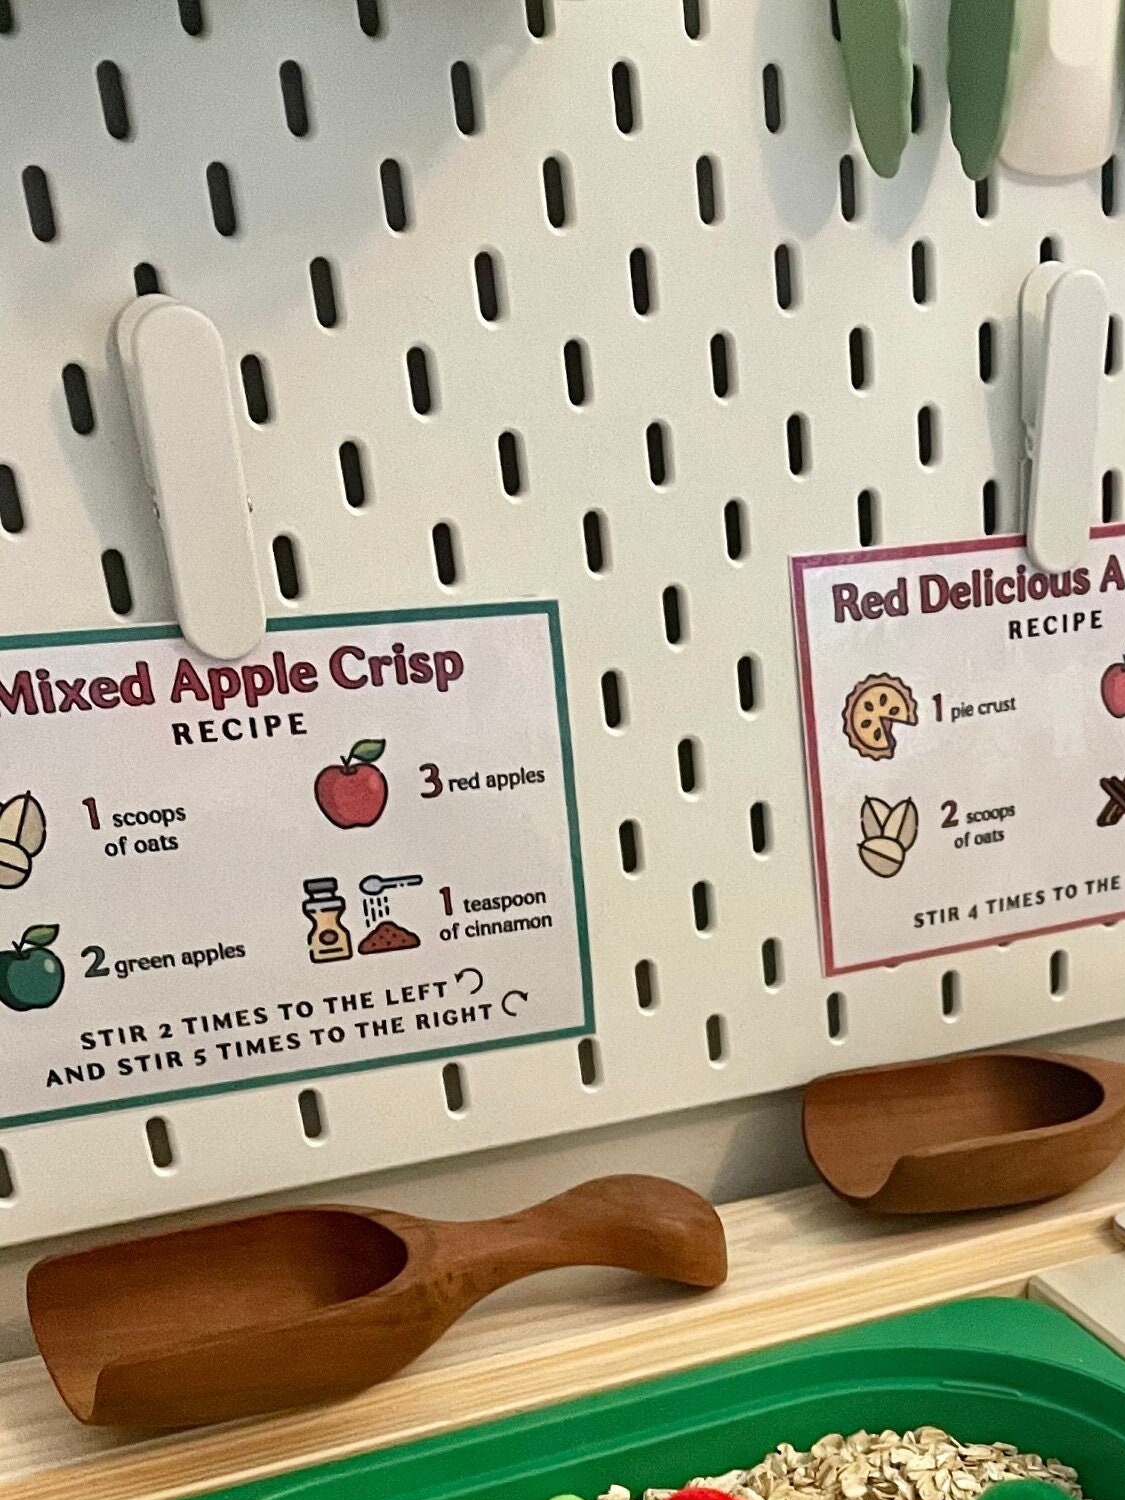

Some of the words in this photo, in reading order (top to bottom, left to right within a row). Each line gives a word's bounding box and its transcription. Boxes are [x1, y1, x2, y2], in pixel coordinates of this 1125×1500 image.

[832, 577, 909, 623] Red
[919, 564, 1091, 613] Delicious
[1008, 610, 1103, 640] RECIPE
[0, 661, 156, 715] Mixed
[170, 651, 319, 711] Apple
[329, 642, 464, 692] Crisp
[932, 693, 943, 722] 1
[951, 702, 974, 723] pie
[978, 697, 1017, 715] crust
[171, 712, 308, 745] RECIPE
[419, 763, 443, 799] 3
[448, 772, 480, 792] red
[486, 766, 545, 791] apples
[82, 796, 100, 830] 1
[112, 807, 186, 828] scoops
[941, 800, 959, 828] 2
[966, 805, 1016, 824] scoops
[105, 836, 127, 857] of
[134, 835, 179, 854] oats
[954, 831, 971, 849] of
[974, 830, 1005, 845] oats
[439, 886, 453, 916] 1
[463, 891, 546, 913] teaspoon
[913, 906, 959, 928] STIR
[968, 904, 978, 920] 4
[985, 890, 1045, 914] TIMES
[1051, 884, 1078, 901] TO
[1084, 875, 1121, 895] THE
[439, 922, 460, 941] of
[465, 915, 552, 938] cinnamon
[81, 945, 110, 978] 2
[114, 954, 176, 979] green
[181, 942, 246, 969] apples
[80, 1025, 148, 1050] STIR
[159, 1023, 173, 1039] 2
[181, 1007, 268, 1035] TIMES
[277, 1001, 313, 1020] TO
[323, 991, 374, 1014] THE
[385, 981, 447, 1006] LEFT
[46, 1063, 105, 1088] AND
[117, 1051, 183, 1076] STIR
[194, 1048, 207, 1066] 5
[215, 1033, 301, 1060] TIMES
[310, 1026, 345, 1046] TO
[354, 1016, 405, 1039] THE
[416, 1003, 492, 1030] RIGHT
